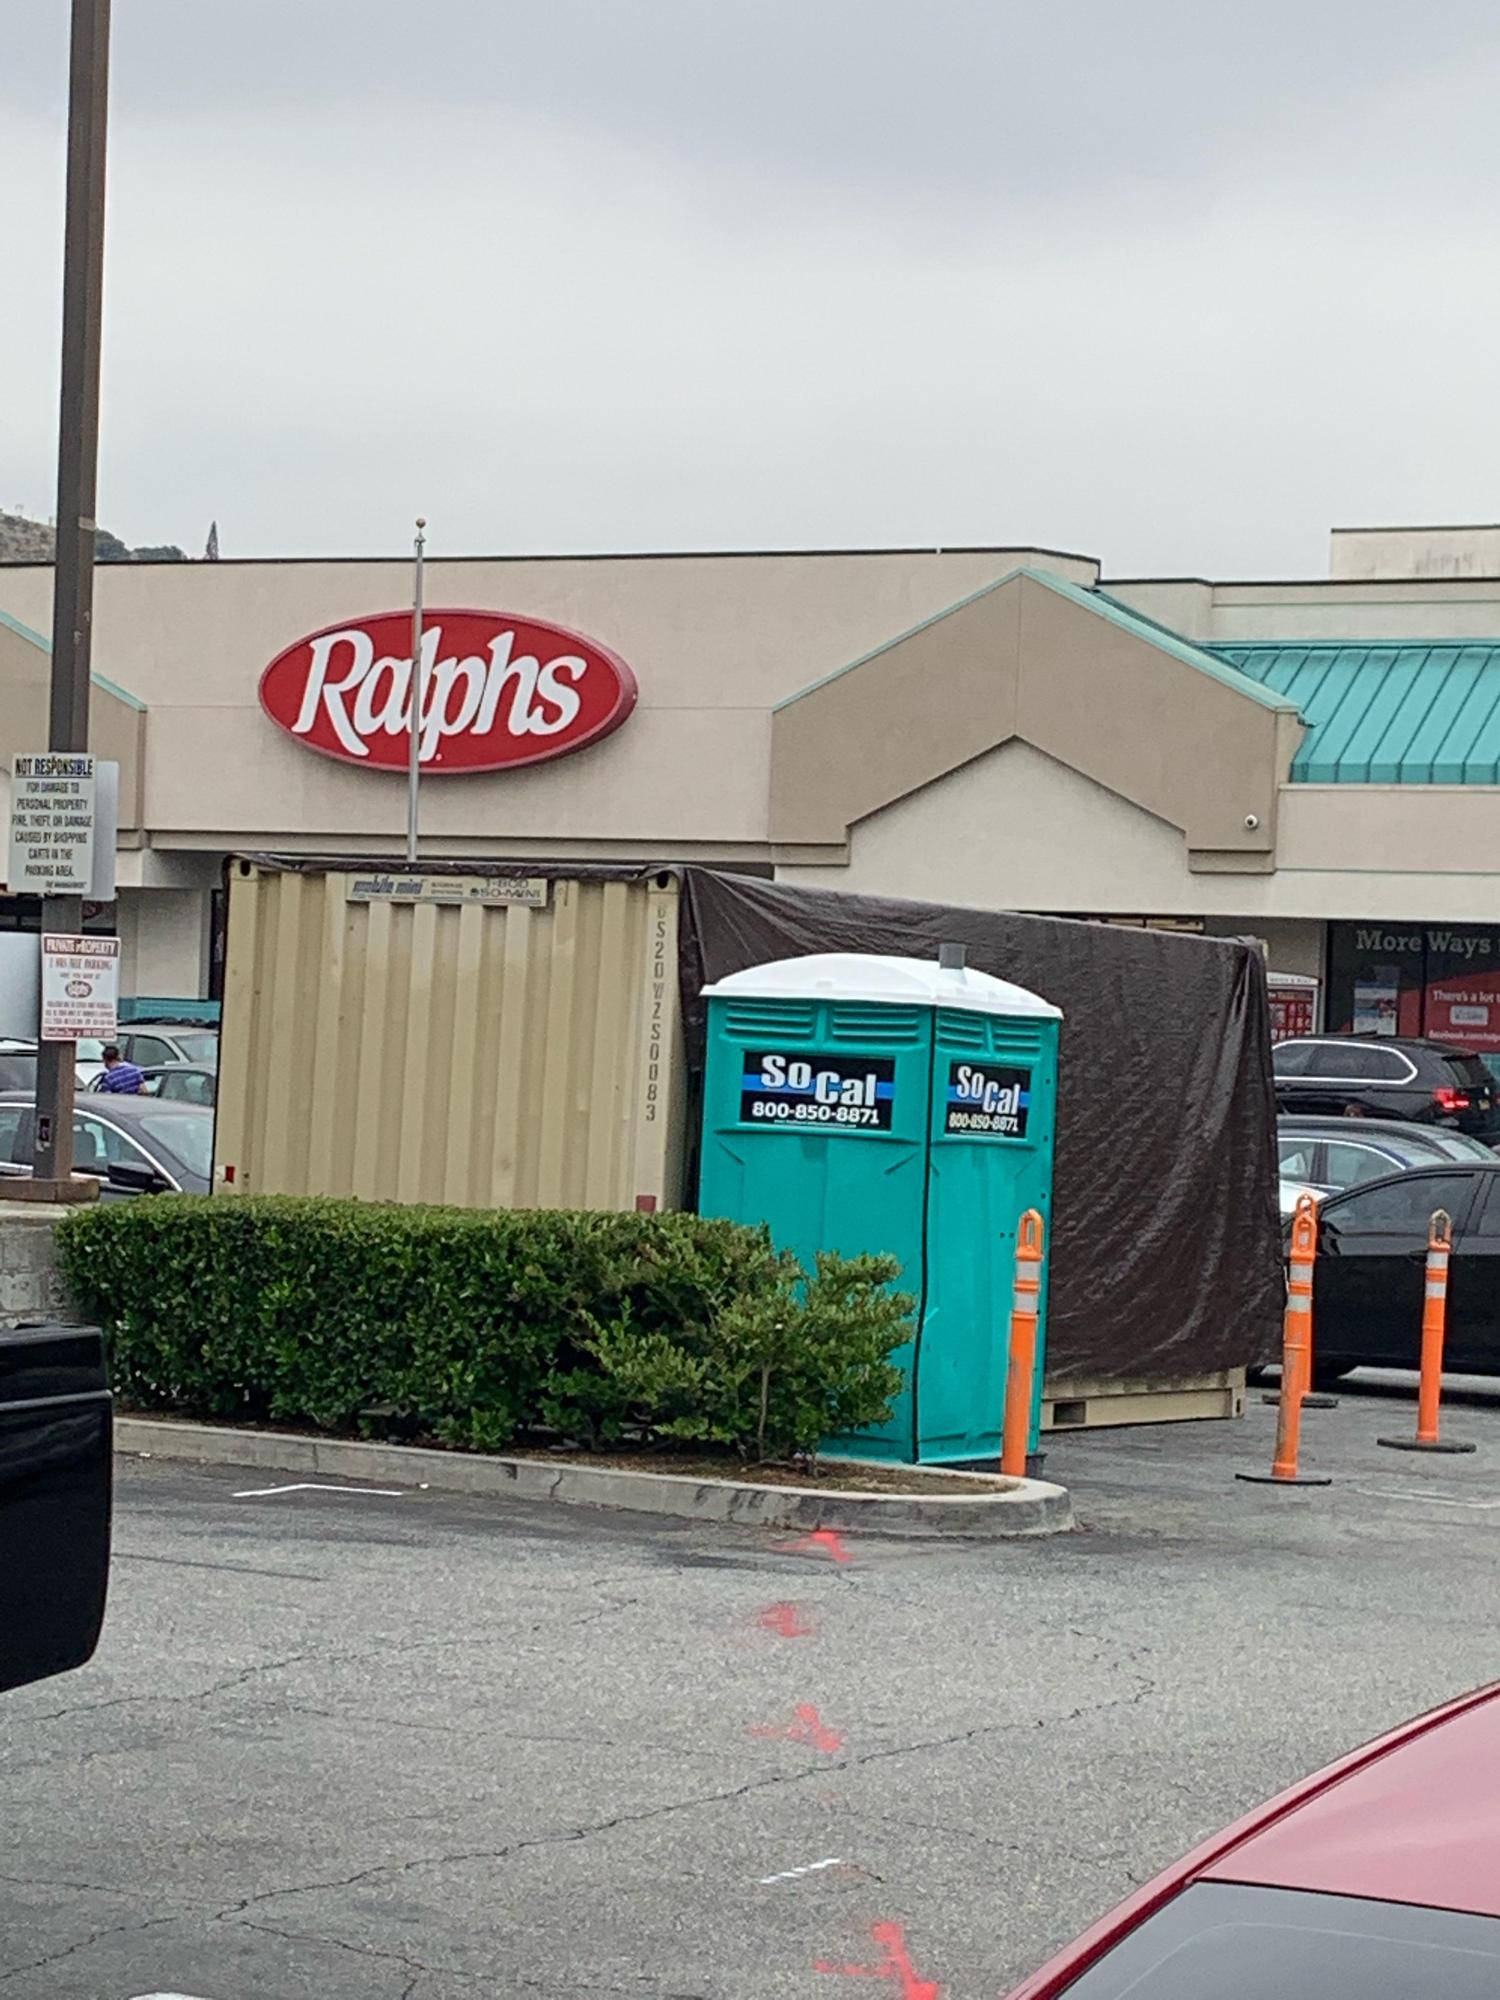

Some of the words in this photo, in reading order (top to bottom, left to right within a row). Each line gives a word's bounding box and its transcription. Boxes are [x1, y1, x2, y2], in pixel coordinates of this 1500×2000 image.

[291, 626, 588, 762] Ralphs
[15, 758, 32, 775] NOT
[34, 757, 92, 775] RESPONSIBLE
[16, 798, 51, 810] PERSONAL
[53, 799, 88, 811] PROPERTY
[25, 865, 54, 876] PARKING
[75, 939, 115, 955] PROPERTY
[1356, 929, 1422, 952] More
[1426, 931, 1491, 959] Ways
[1433, 989, 1469, 1002] There's
[752, 1101, 879, 1125] 800-850-8871
[949, 1111, 1018, 1132] 800-850-8871
